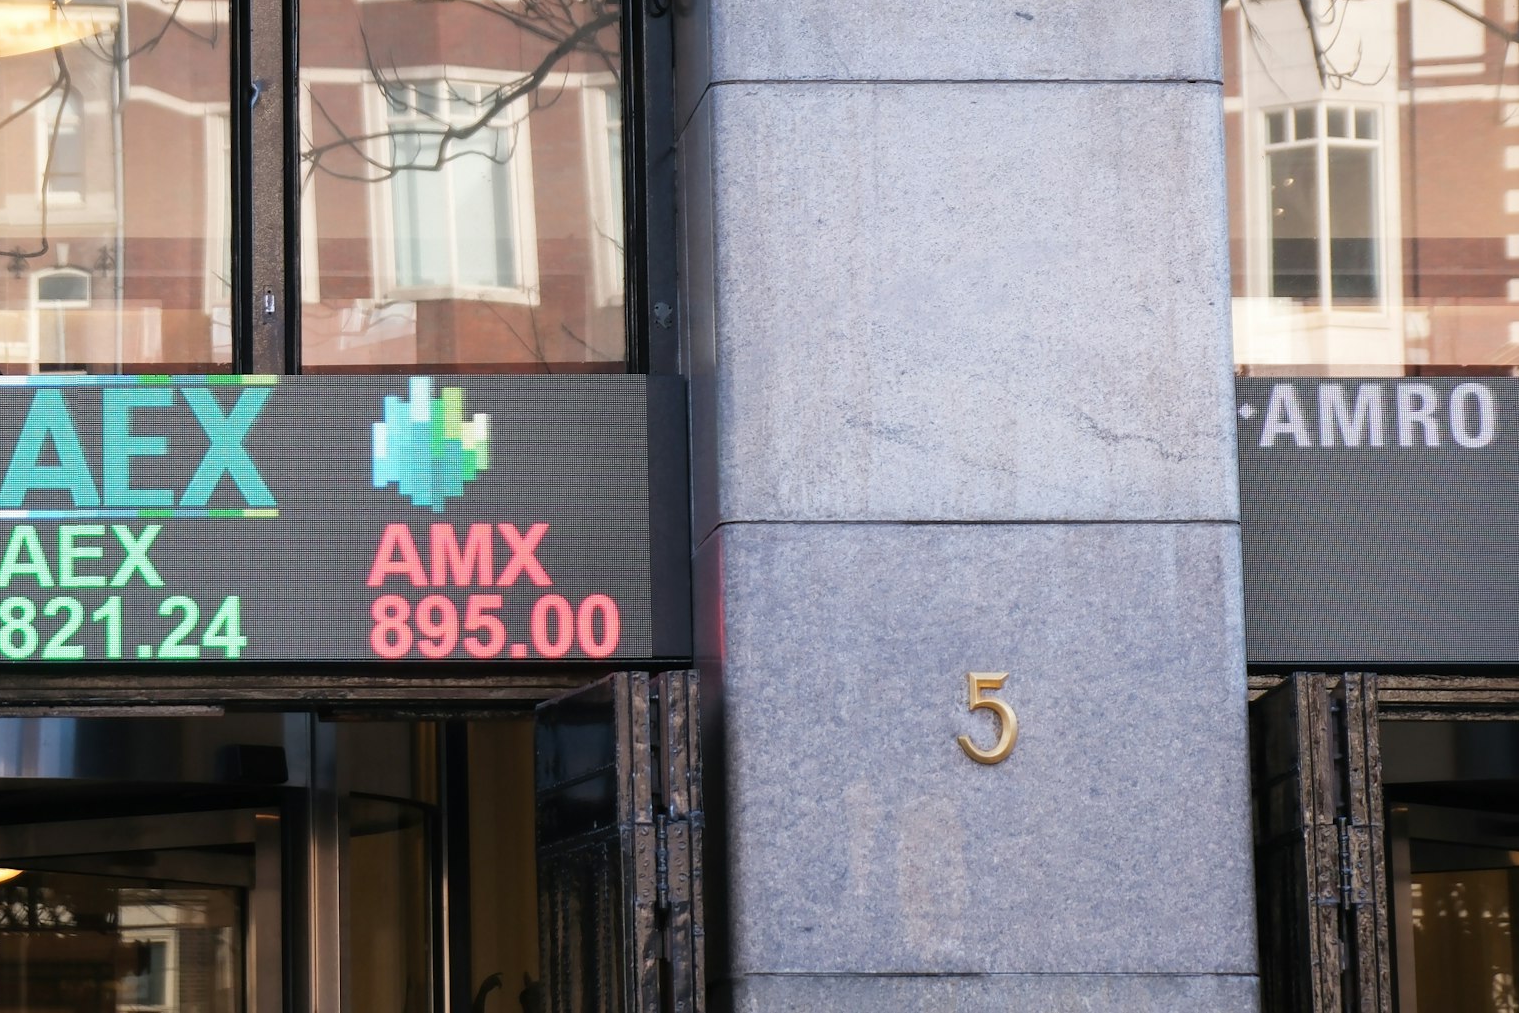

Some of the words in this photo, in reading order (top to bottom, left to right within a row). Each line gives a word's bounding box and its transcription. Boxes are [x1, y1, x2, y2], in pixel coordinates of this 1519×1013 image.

[367, 523, 552, 586] AMX
[369, 594, 620, 658] 895.00
[957, 671, 1019, 765] 5
